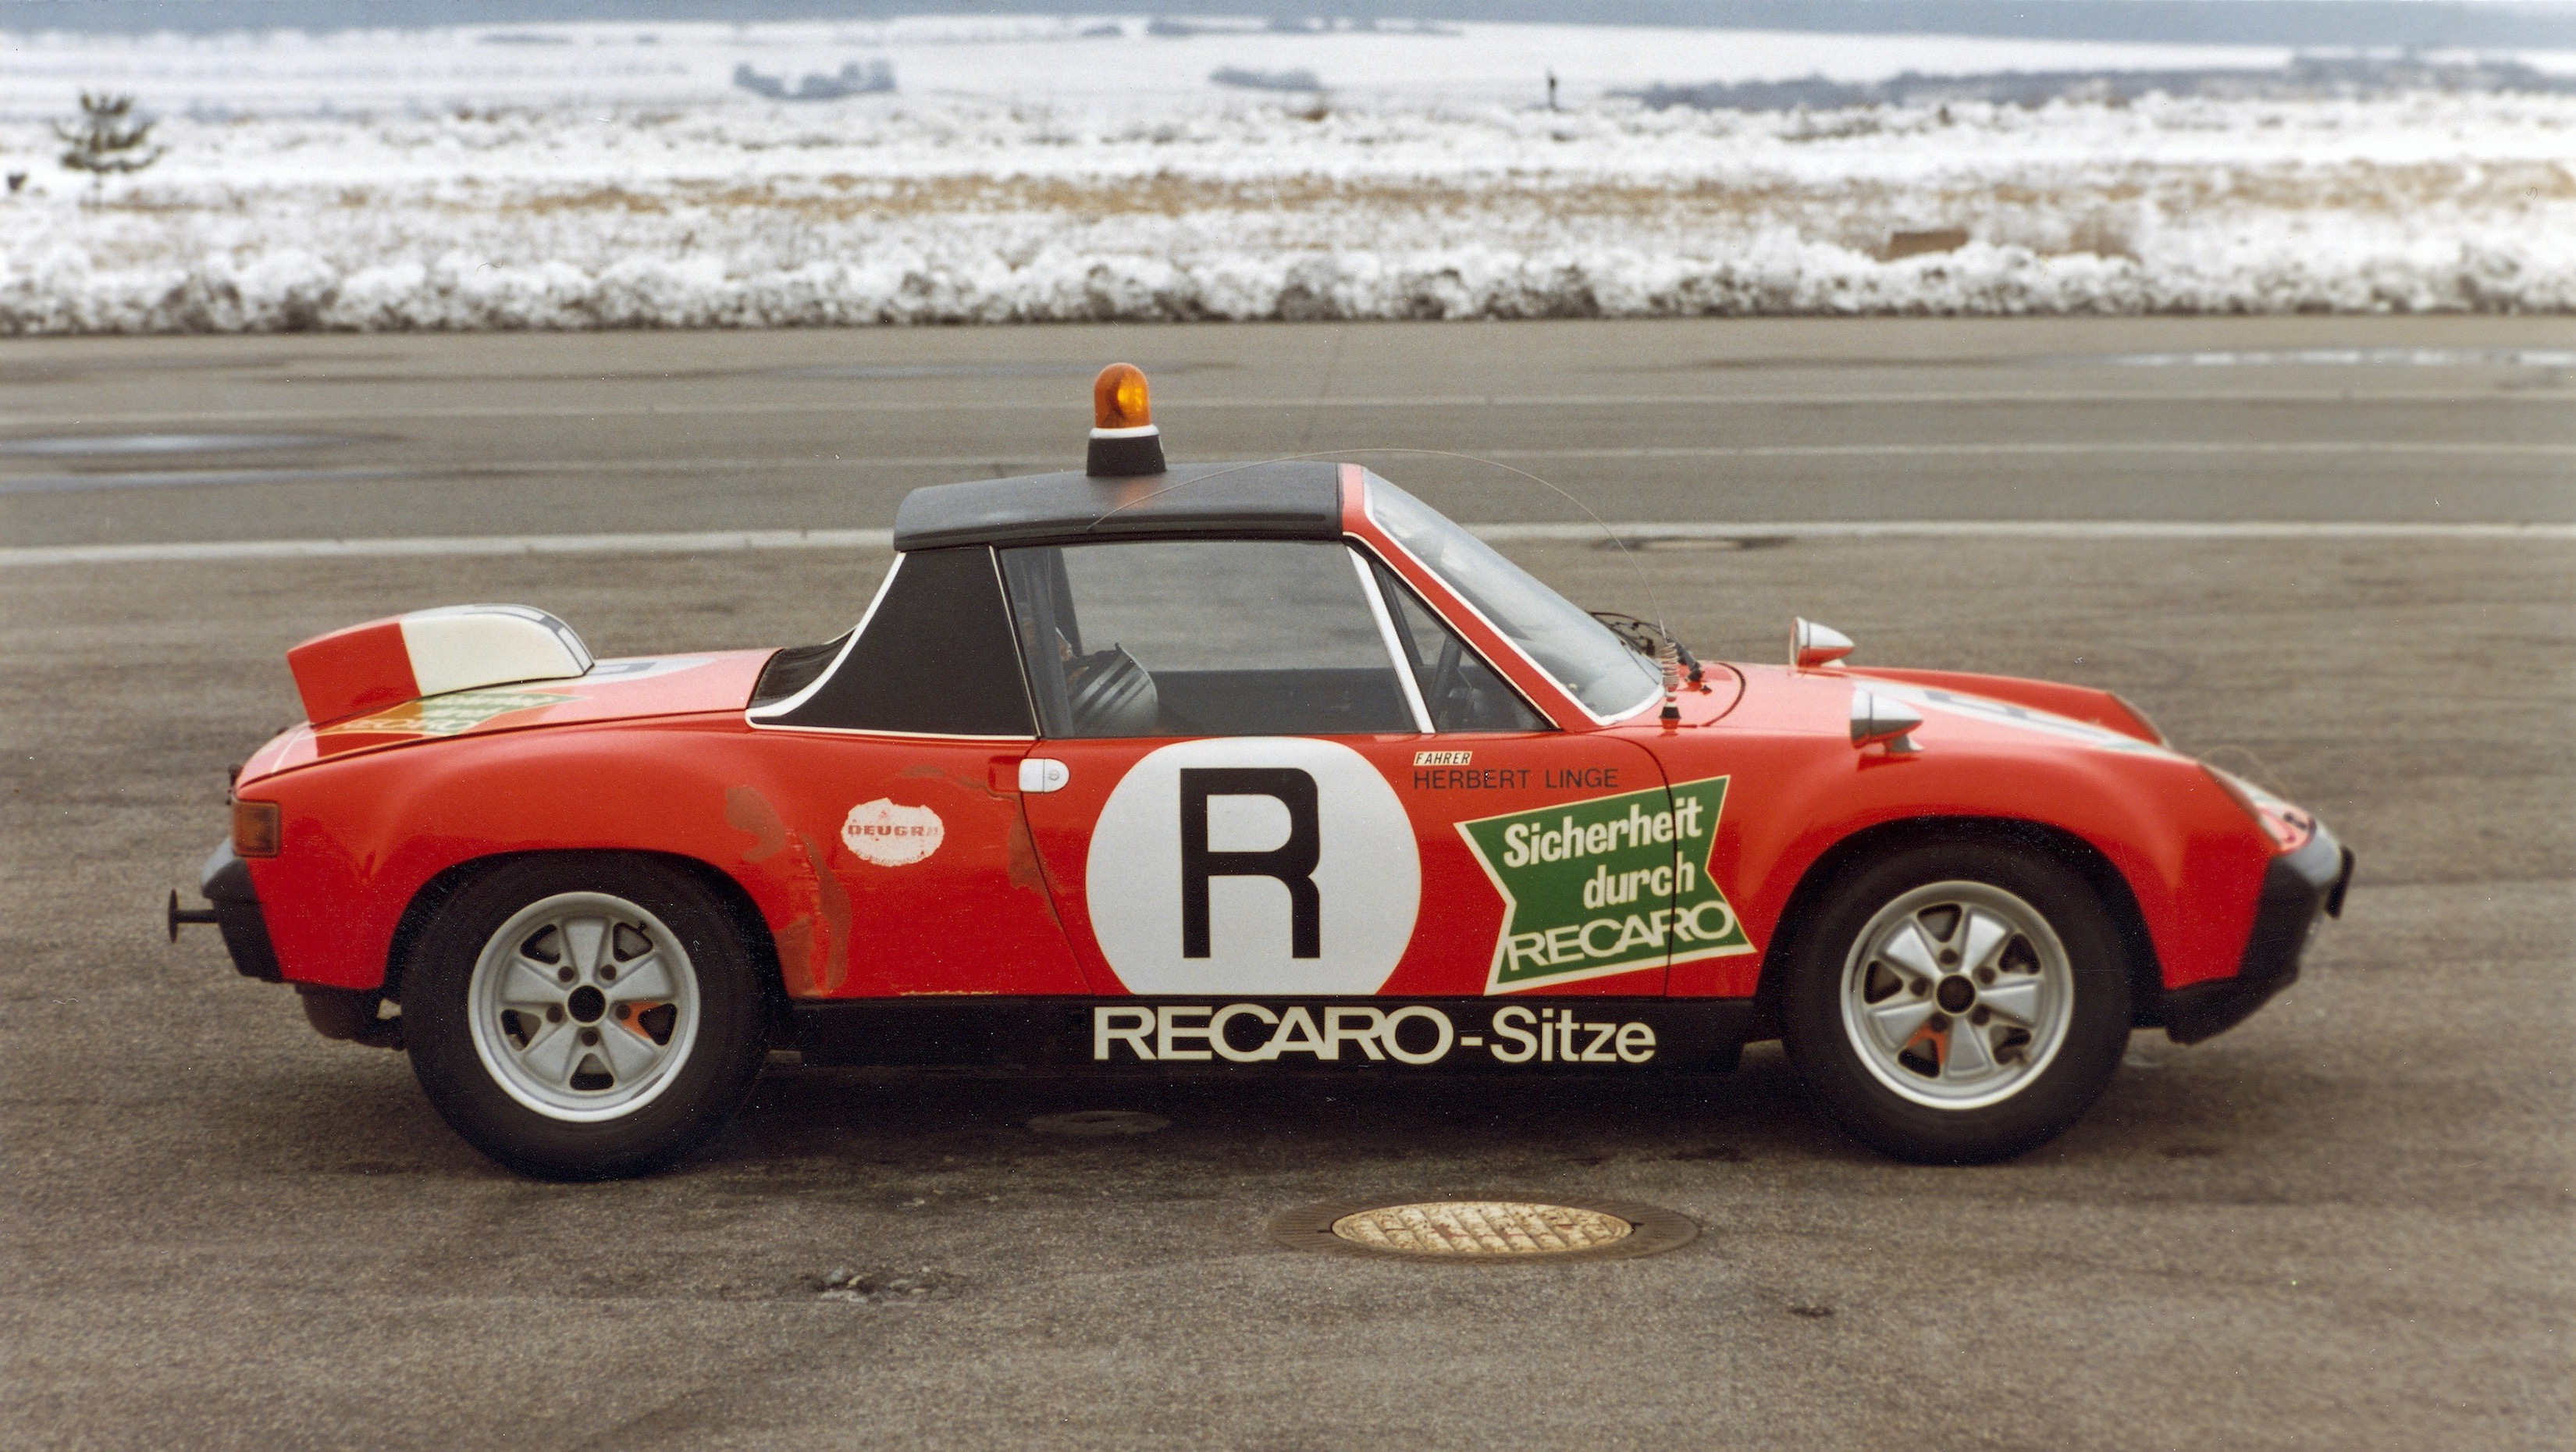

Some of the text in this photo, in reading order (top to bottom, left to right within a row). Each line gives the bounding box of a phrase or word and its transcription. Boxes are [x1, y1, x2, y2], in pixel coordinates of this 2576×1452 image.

[1413, 767, 1619, 790] HERBERT LINGE
[1414, 751, 1471, 765] FAHRER
[1179, 767, 1321, 959] R
[1502, 795, 1703, 869] Sicherheit
[1582, 851, 1695, 910] durch
[1503, 900, 1736, 972] RECARO
